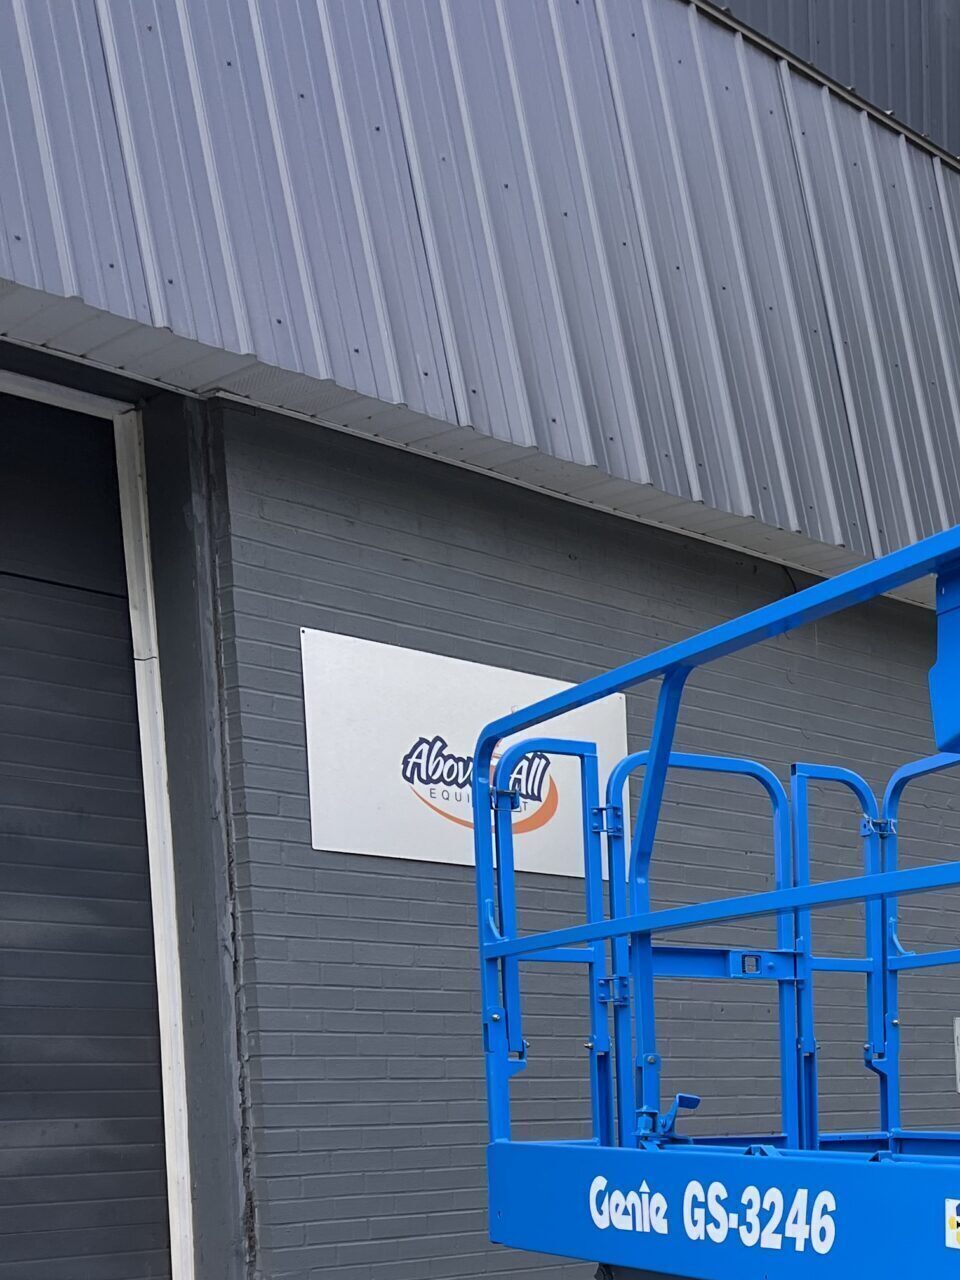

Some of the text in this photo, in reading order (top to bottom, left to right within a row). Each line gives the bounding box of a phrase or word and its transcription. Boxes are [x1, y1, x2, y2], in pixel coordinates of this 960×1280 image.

[402, 736, 551, 802] Abov All
[589, 1175, 837, 1255] Genie GS-3246
